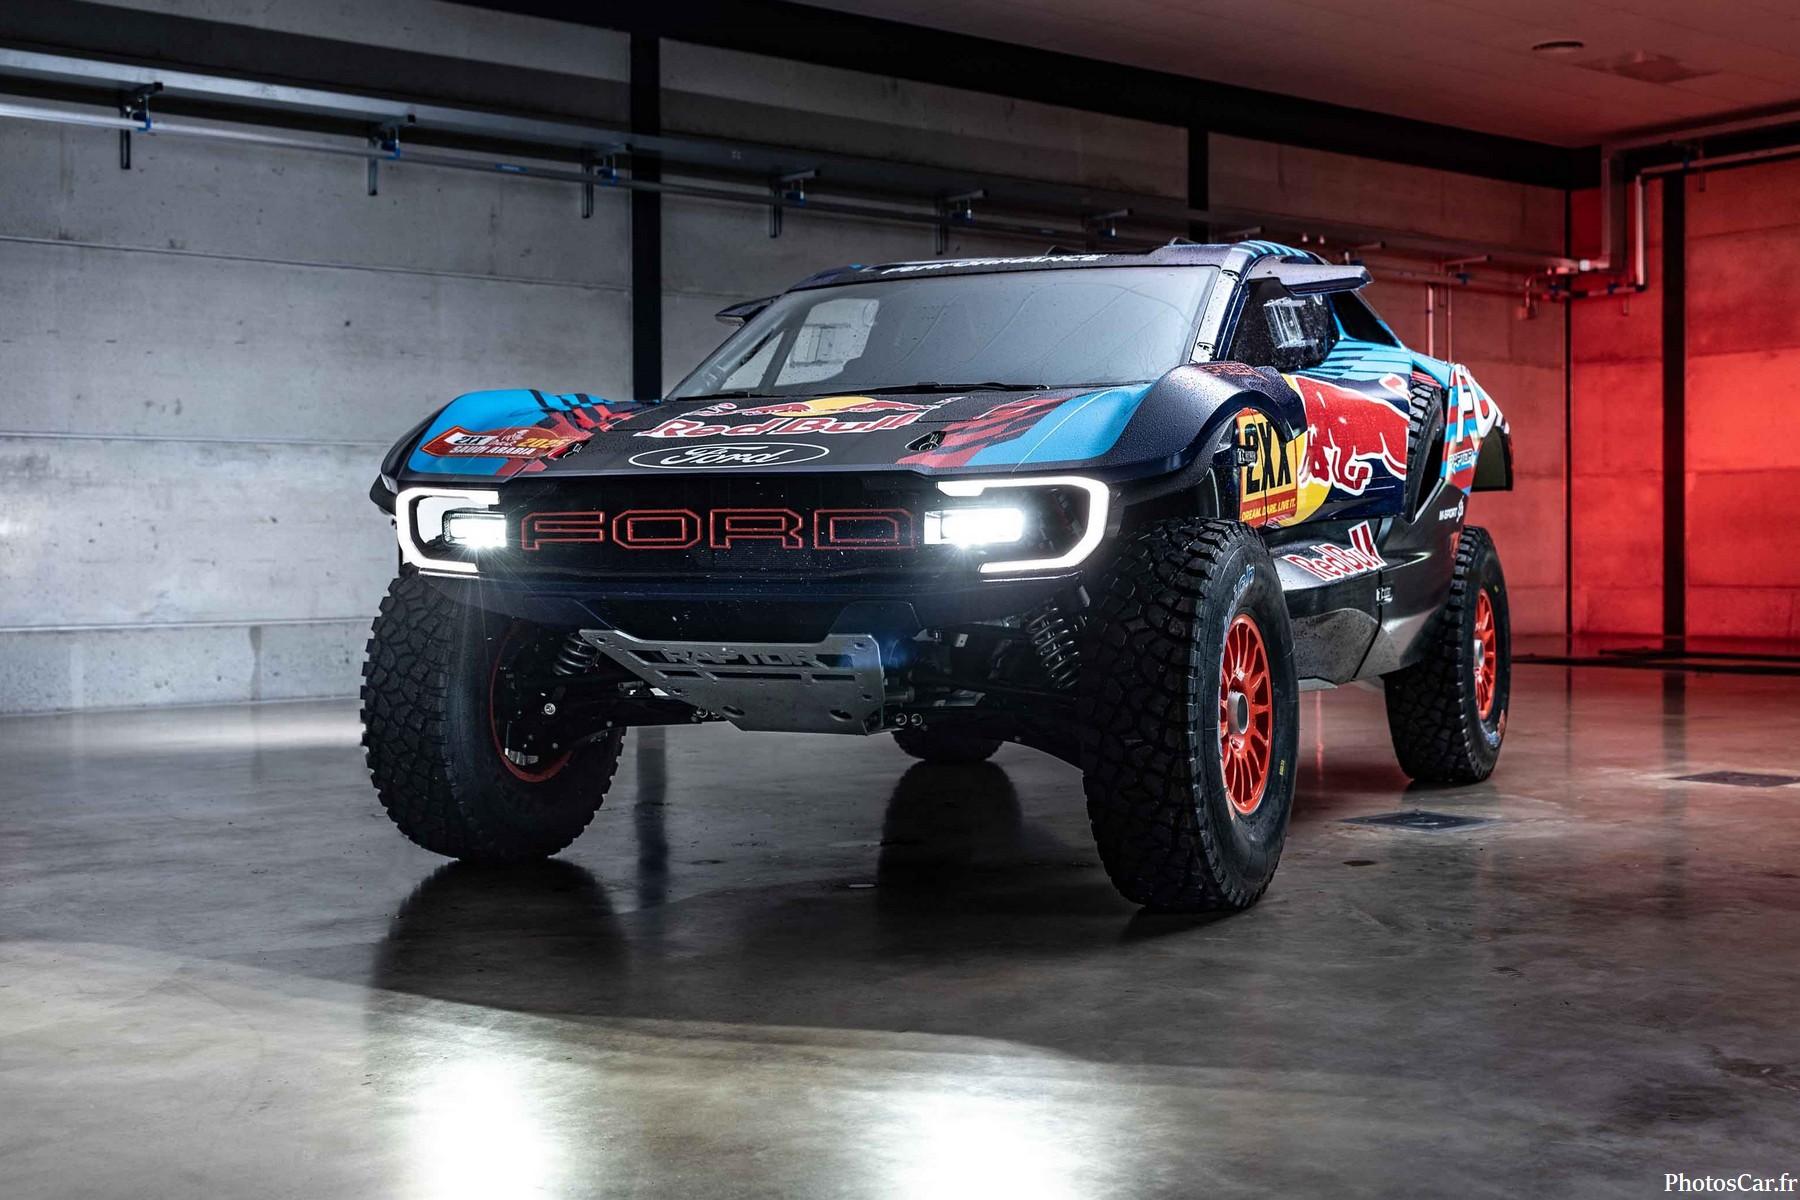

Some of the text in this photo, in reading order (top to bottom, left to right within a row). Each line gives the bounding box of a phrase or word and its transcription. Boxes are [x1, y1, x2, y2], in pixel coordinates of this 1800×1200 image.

[632, 411, 924, 438] Red Bull
[448, 445, 537, 456] SAUDI ARABIA
[520, 508, 916, 550] FORD
[660, 649, 830, 671] RAPTOR
